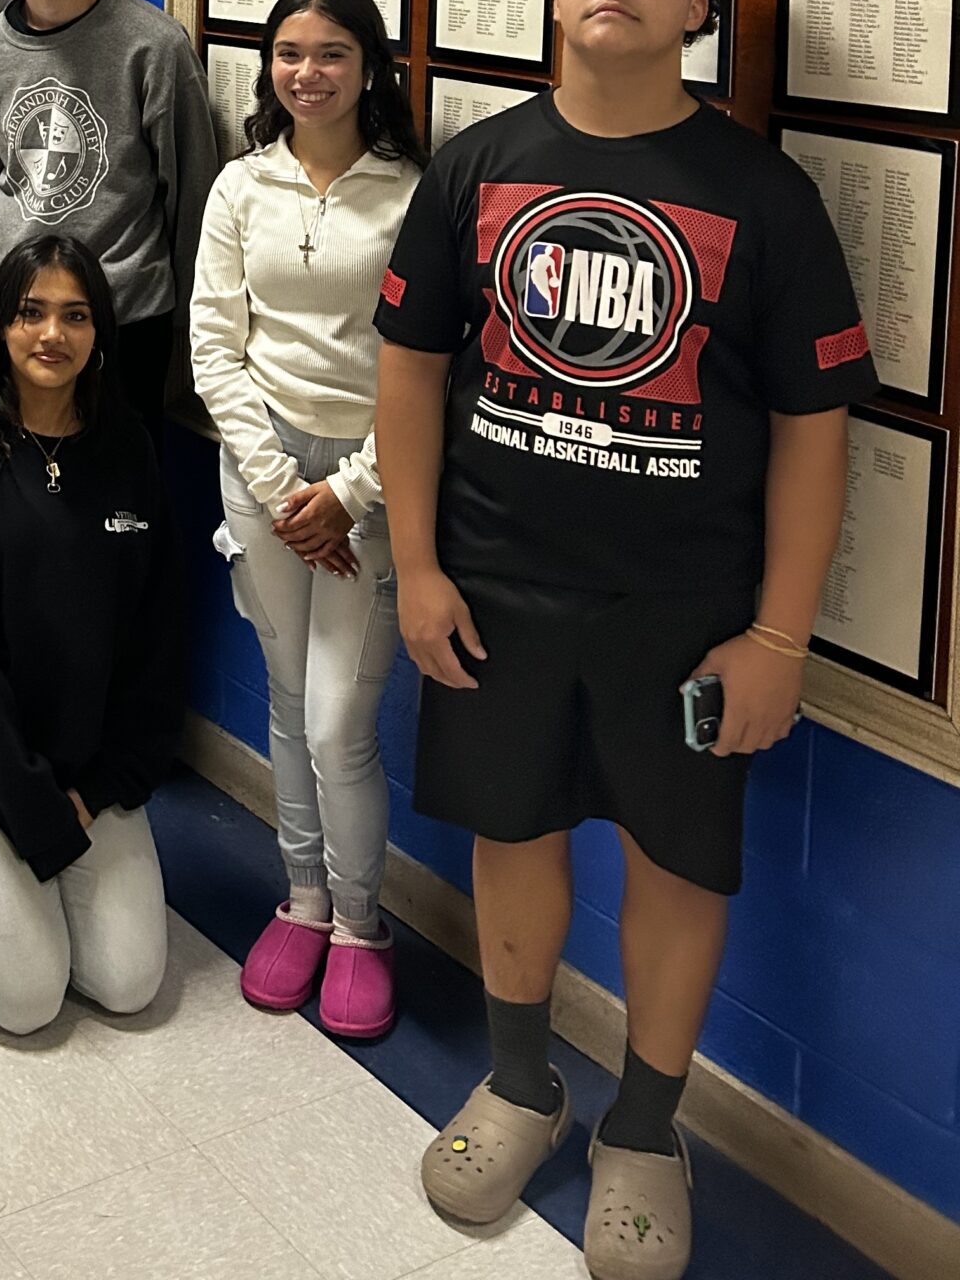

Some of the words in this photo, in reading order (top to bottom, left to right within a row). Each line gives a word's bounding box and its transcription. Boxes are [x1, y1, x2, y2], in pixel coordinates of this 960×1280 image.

[72, 102, 100, 153] VALLEY
[50, 175, 90, 209] CLUB
[564, 249, 655, 336] NBA
[484, 371, 703, 431] ESTABLISHED
[470, 413, 530, 451] NATIONAL
[533, 435, 641, 474] BASKETBALL
[646, 457, 701, 478] ASSOC
[559, 420, 593, 439] 1946
